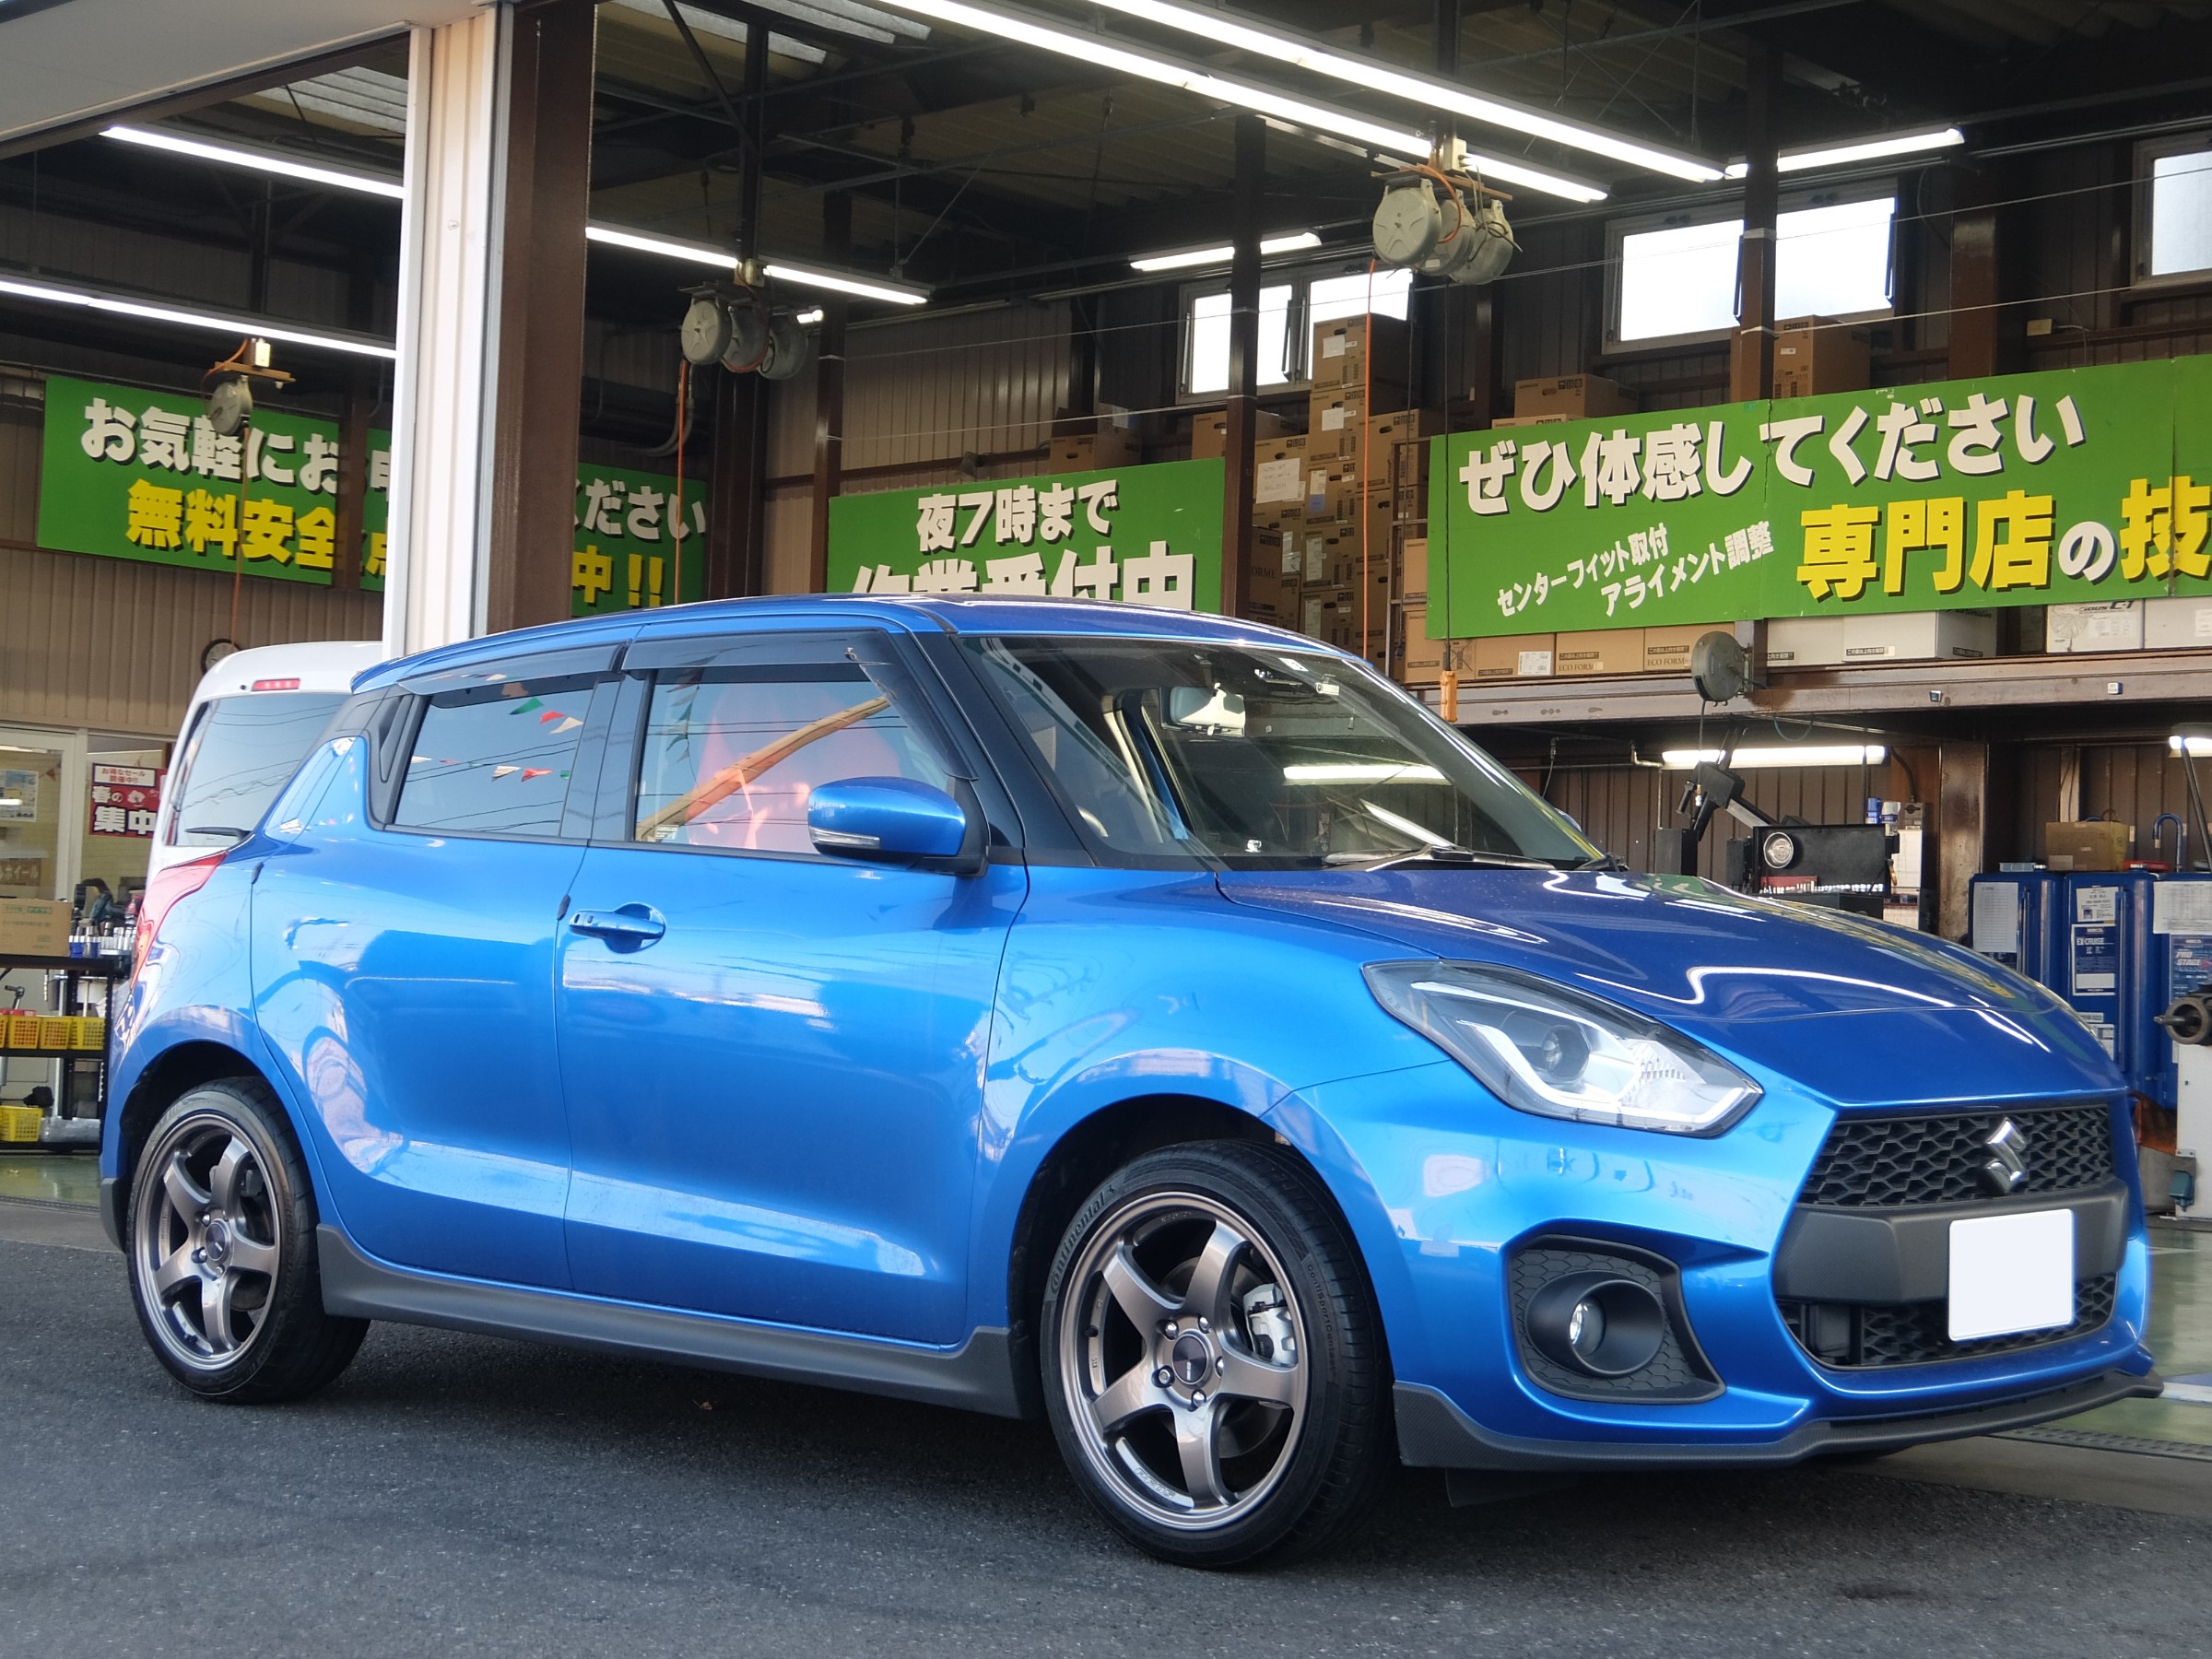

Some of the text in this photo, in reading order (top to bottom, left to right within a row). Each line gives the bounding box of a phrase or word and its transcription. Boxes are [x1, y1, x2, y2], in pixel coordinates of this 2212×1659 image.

[1459, 392, 2085, 516] ぜひ体感してください
[575, 477, 706, 540] ださい
[1796, 476, 2212, 600] 専門店の技
[1497, 522, 1669, 617] センターフィット取付
[1601, 521, 1774, 617] アライメント調整
[1648, 658, 1663, 666] ECO
[92, 786, 124, 804] 春の
[93, 806, 157, 835] 集中
[1050, 1190, 1107, 1294] Continental
